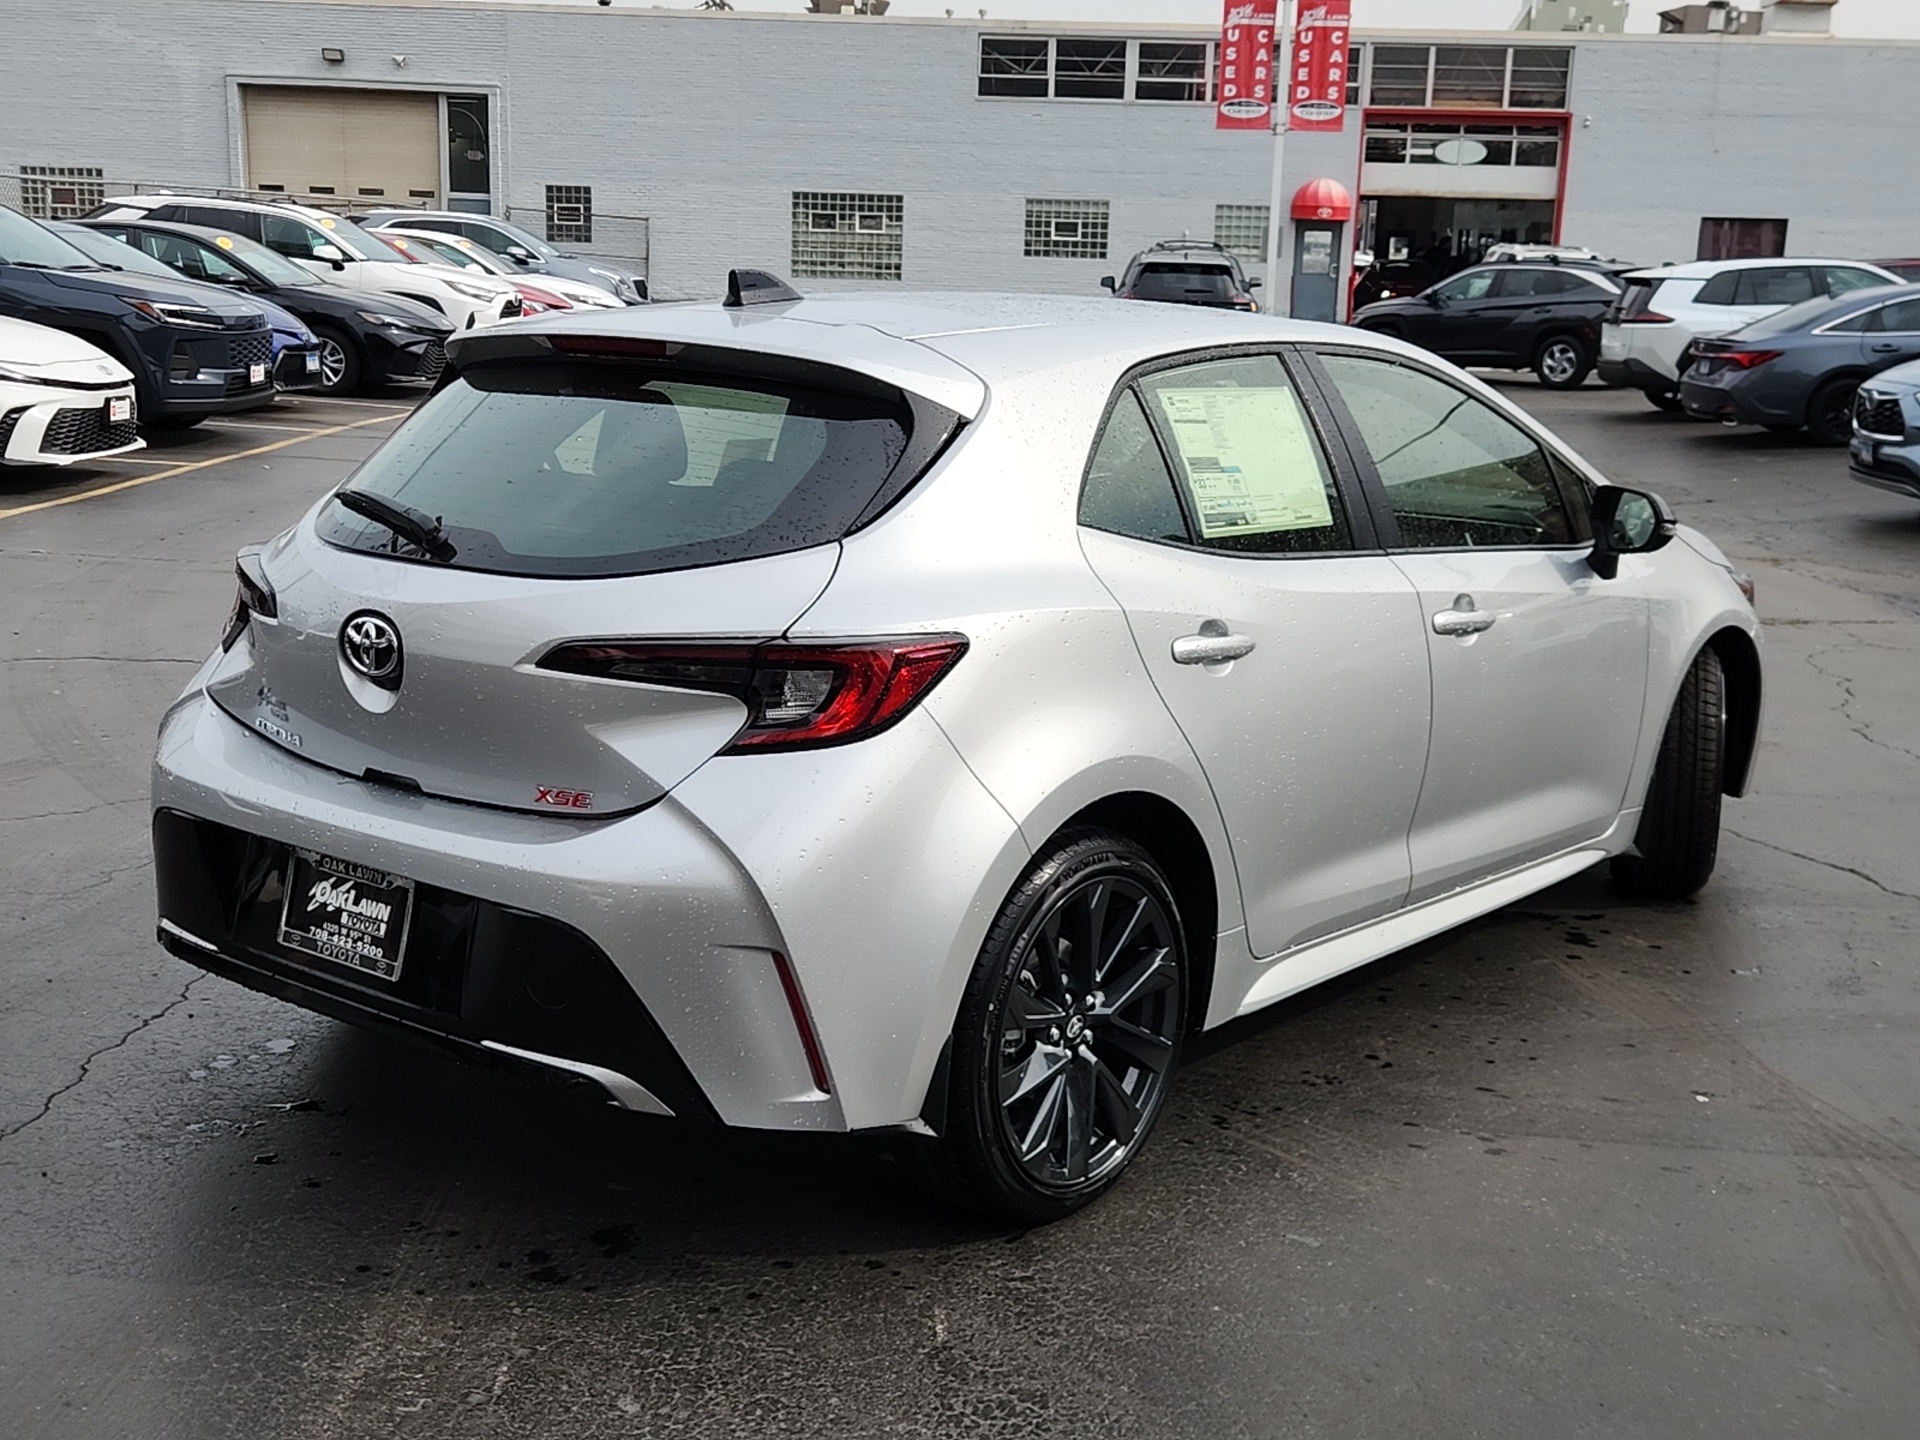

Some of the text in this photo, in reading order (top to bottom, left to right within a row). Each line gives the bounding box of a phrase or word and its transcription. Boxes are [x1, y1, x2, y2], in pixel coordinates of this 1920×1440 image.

[1224, 29, 1240, 97] USED
[1254, 30, 1270, 98] CARS
[1296, 31, 1313, 99] USED
[1327, 31, 1344, 100] CARS
[534, 785, 594, 811] XSE
[322, 857, 383, 885] OAK LAWN
[309, 925, 384, 958] 708-423-5200
[316, 940, 360, 966] TOYOTA
